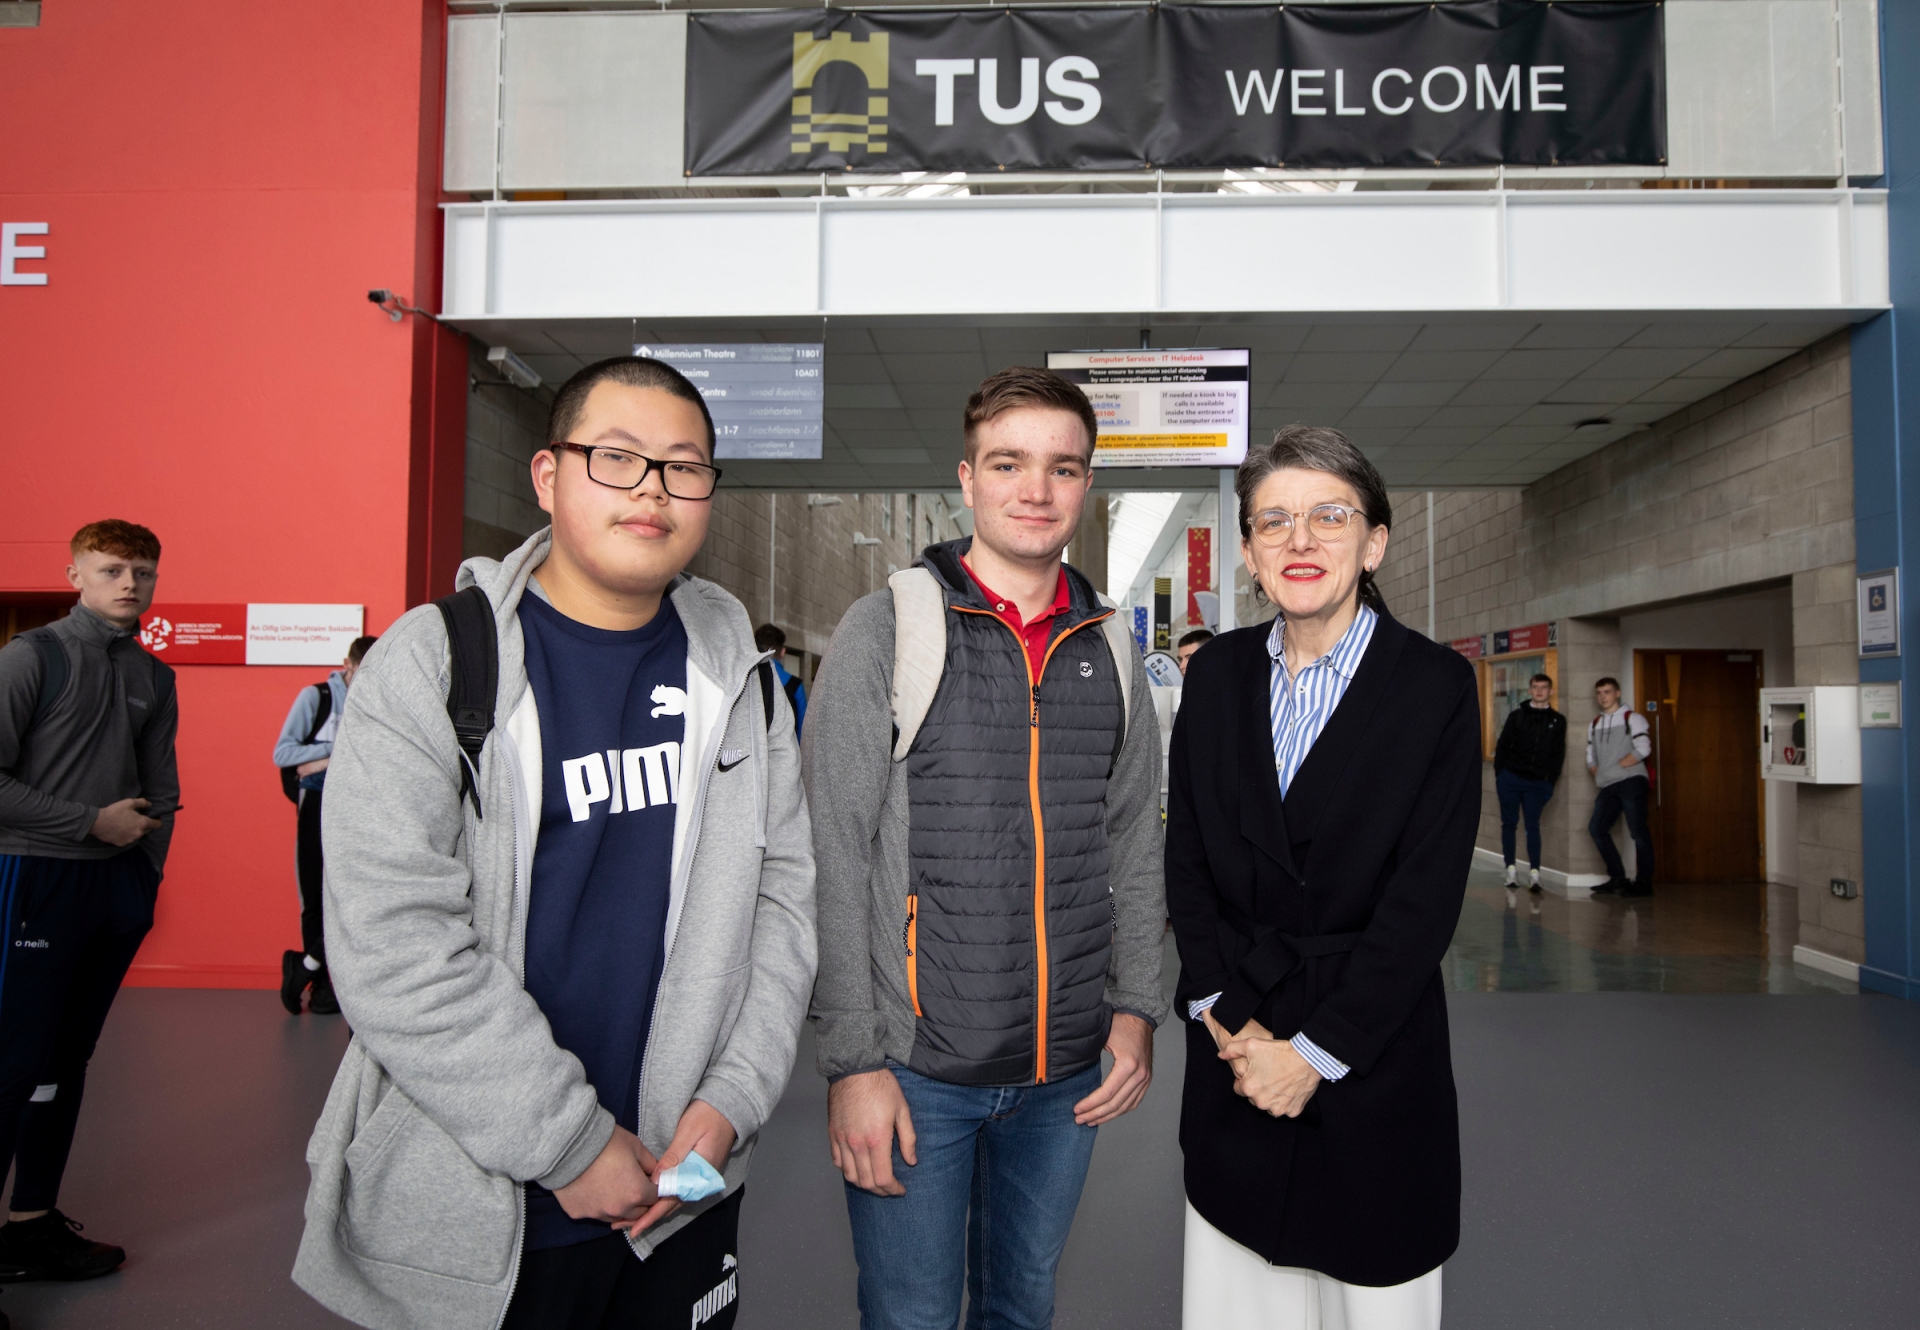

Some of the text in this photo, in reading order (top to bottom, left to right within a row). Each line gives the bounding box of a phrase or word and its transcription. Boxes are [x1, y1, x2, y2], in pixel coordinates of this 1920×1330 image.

[916, 55, 1567, 126] TUS WELCOME
[0, 222, 49, 285] E
[654, 349, 736, 358] Millennium Theatre
[796, 349, 820, 358] 11B01
[1089, 356, 1124, 364] Computer
[1171, 354, 1204, 363] Helpdesk
[795, 369, 819, 377] 10A01
[698, 387, 727, 397] Centre
[724, 425, 739, 435] 1-7
[278, 634, 308, 642] Learning
[722, 749, 741, 762] NIKE
[562, 741, 683, 822] PUM
[691, 1270, 736, 1330] PUMA
